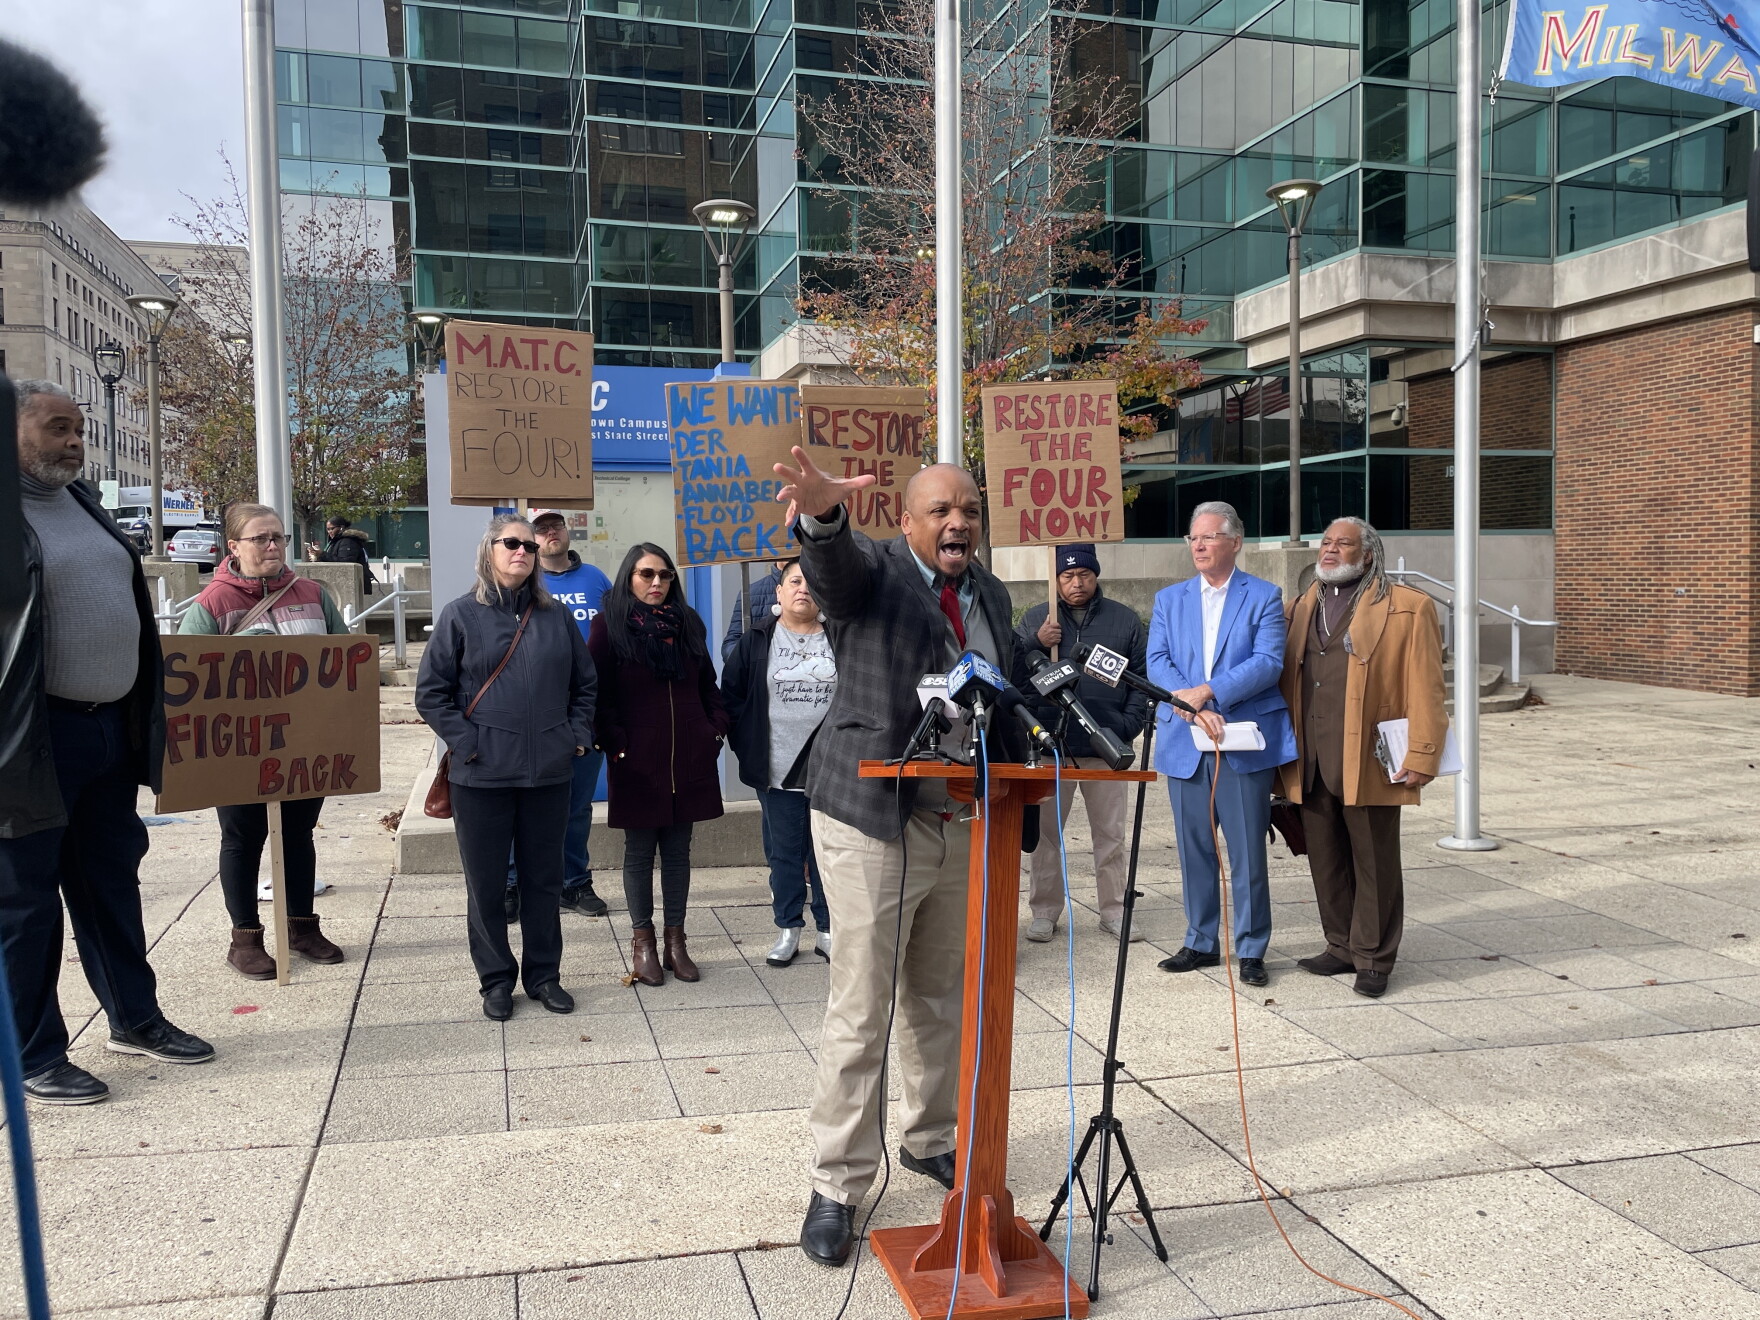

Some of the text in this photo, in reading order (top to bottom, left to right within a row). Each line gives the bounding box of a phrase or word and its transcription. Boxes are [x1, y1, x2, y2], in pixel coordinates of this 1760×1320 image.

[1534, 4, 1760, 94] MILWA
[455, 331, 581, 376] M.A.T.C.
[455, 372, 569, 406] RESTORE
[495, 408, 539, 430] THE
[669, 384, 800, 429] WE WANT:
[993, 393, 1112, 433] RESTORE
[591, 417, 668, 430] own Campus
[591, 430, 669, 441] st State Street
[807, 405, 923, 457] RESTORE
[462, 428, 580, 479] FOUR!
[674, 428, 729, 459] DER
[1020, 432, 1093, 462] THE
[677, 454, 751, 482] TANIA
[840, 456, 894, 487] THE
[1003, 466, 1113, 509] FOUR
[163, 497, 195, 510] WERNER
[684, 503, 754, 529] FLOYD
[847, 489, 903, 529] UR!
[1020, 507, 1111, 543] NOW!
[684, 522, 796, 564] BACK!
[1090, 649, 1105, 666] FOX
[1101, 656, 1117, 671] 6
[164, 642, 373, 707] STAND UP
[775, 681, 833, 698] I just have to be
[1036, 668, 1060, 685] SPECTRUM
[1043, 672, 1065, 687] NEWS
[782, 694, 829, 708] dramatic first
[167, 713, 291, 764] FIGHT
[258, 753, 358, 796] BACK
